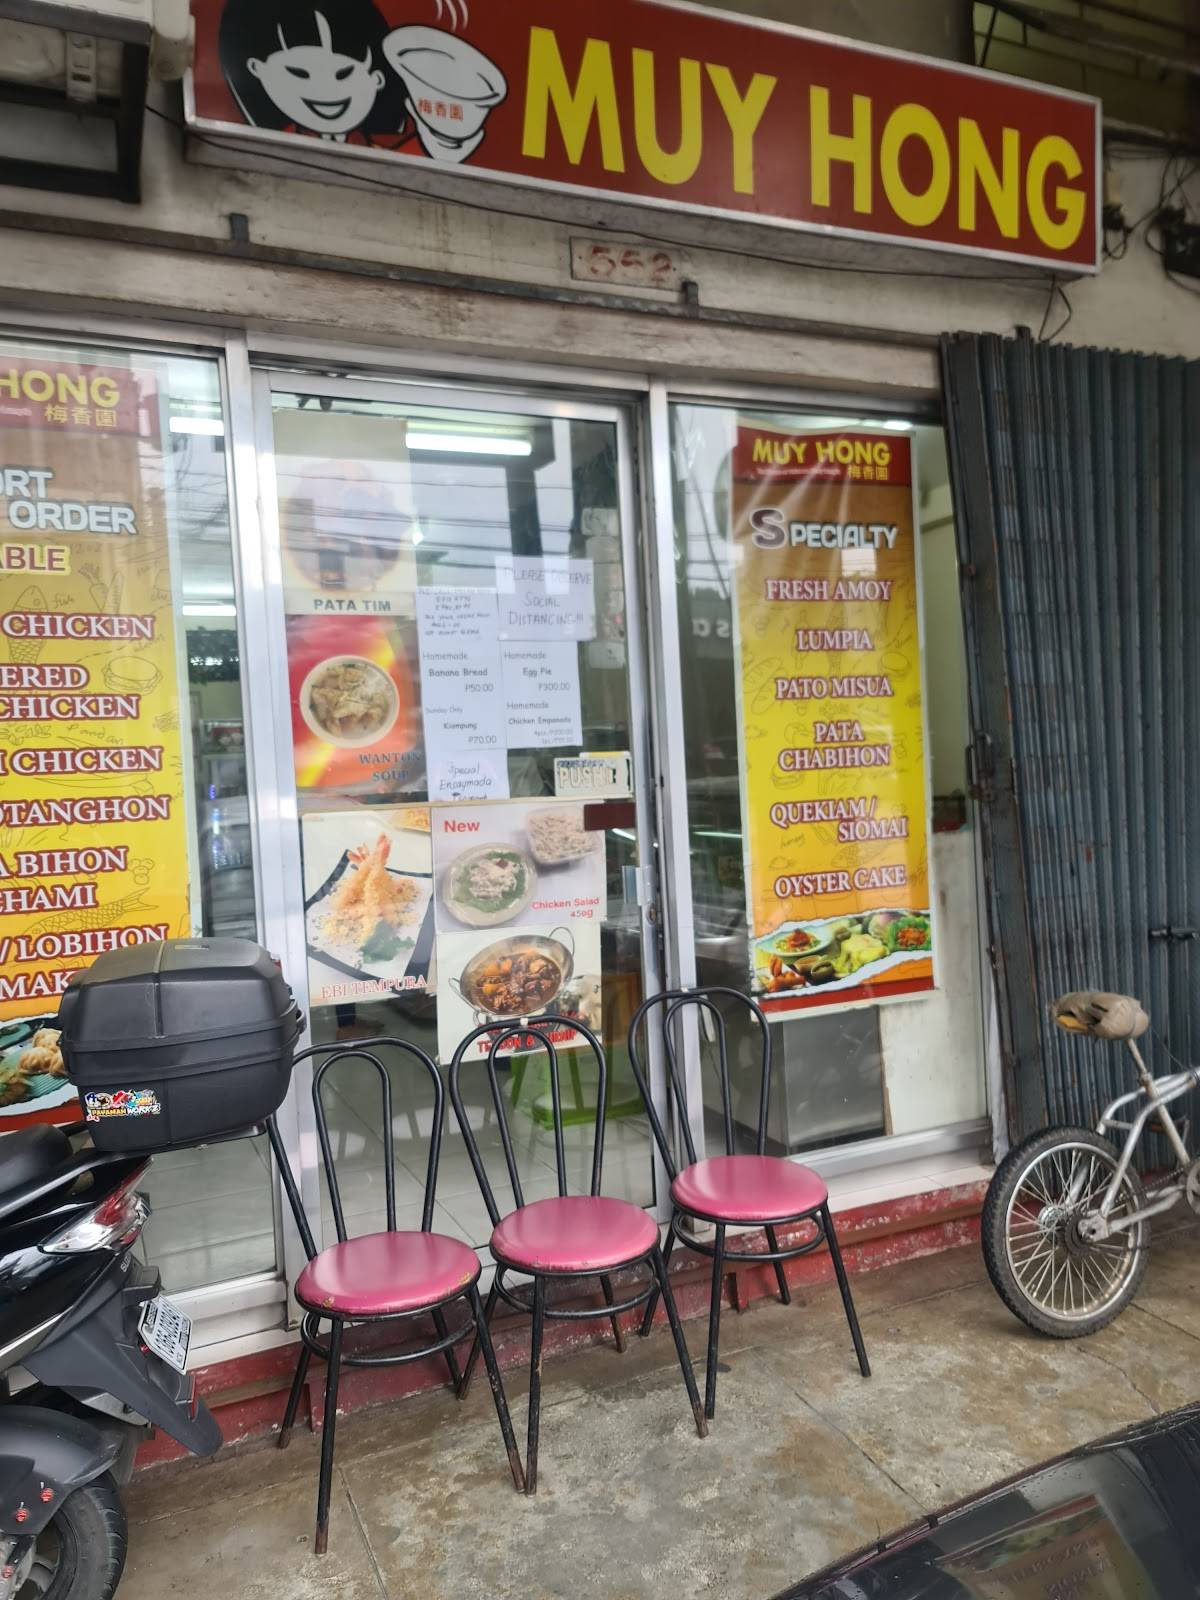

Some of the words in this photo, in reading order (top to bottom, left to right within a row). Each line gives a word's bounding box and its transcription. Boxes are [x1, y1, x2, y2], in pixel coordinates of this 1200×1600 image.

[522, 26, 777, 195] MUY
[809, 85, 1086, 250] HONG
[752, 438, 806, 465] MUY
[816, 440, 891, 466] HONG
[0, 468, 53, 499] RT
[9, 500, 137, 534] ORDER
[751, 508, 898, 549] SPECIALTY
[0, 546, 65, 571] BLE
[767, 580, 828, 601] FRESH
[834, 580, 892, 601] AMOY
[314, 599, 357, 611] PATA
[362, 600, 391, 612] TIM
[3, 614, 154, 638] CHICKEN
[796, 629, 873, 651] LUMPIA
[428, 668, 460, 677] Banana
[463, 667, 488, 677] Bread
[523, 667, 538, 678] Egg
[776, 677, 827, 700] PATO
[831, 676, 894, 698] MISUA
[815, 721, 864, 742] PATA
[12, 748, 162, 773] CHICKEN
[778, 745, 891, 771] CHABIHON
[373, 770, 409, 782] SOUP
[0, 797, 169, 826] TANGHON
[444, 820, 480, 833] New
[838, 817, 908, 842] SIOMAI
[17, 848, 127, 876] BIHON
[775, 872, 850, 897] OYSTER
[854, 865, 906, 889] CAKE
[0, 884, 96, 913] HAMI
[532, 900, 571, 910] Chicken
[574, 897, 600, 906] Salad
[321, 982, 348, 999] EBI
[350, 974, 426, 995] TEMPURA
